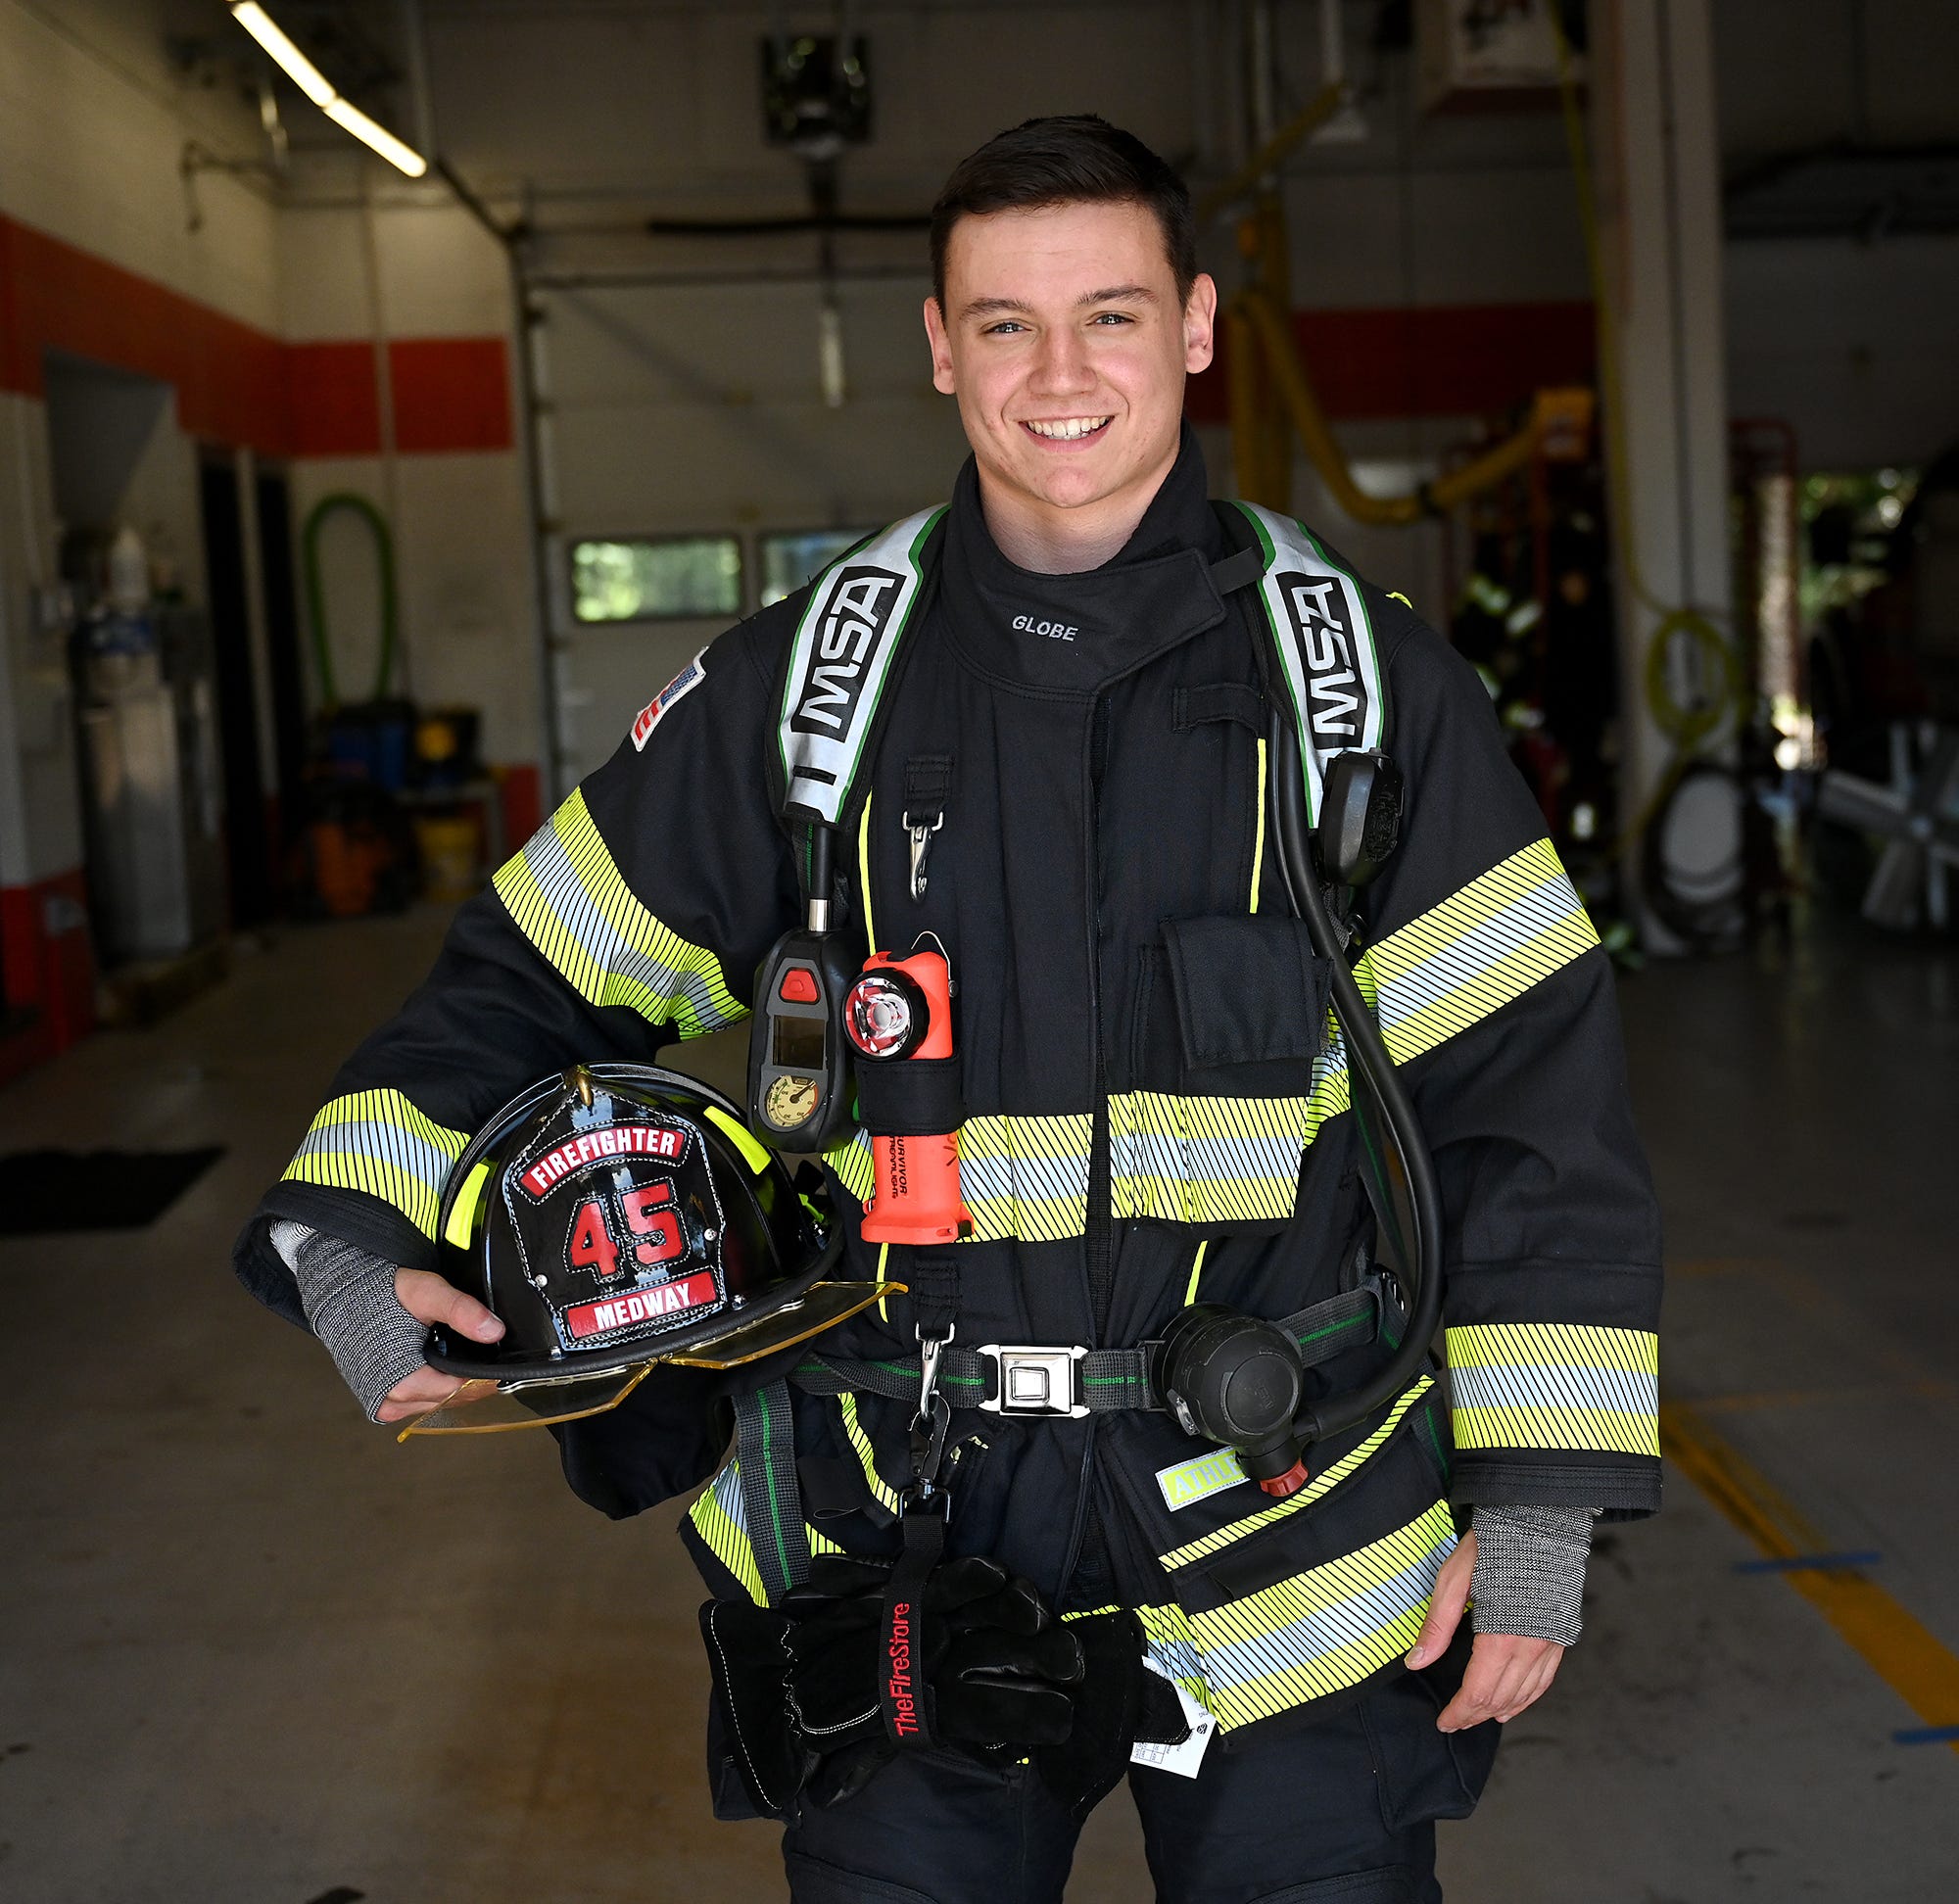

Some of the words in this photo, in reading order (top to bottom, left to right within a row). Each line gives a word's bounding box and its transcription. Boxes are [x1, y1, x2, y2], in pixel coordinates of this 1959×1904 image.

[799, 576, 895, 730] MSA
[1012, 615, 1078, 642] GLOBE
[1291, 582, 1359, 736] MSA
[530, 1127, 676, 1190] FIREFIGHTER
[889, 1136, 898, 1198] TREAMLIGHT
[571, 1182, 683, 1275] 45
[594, 1283, 690, 1330] MEDWAY
[888, 1602, 919, 1737] TheFireStore
